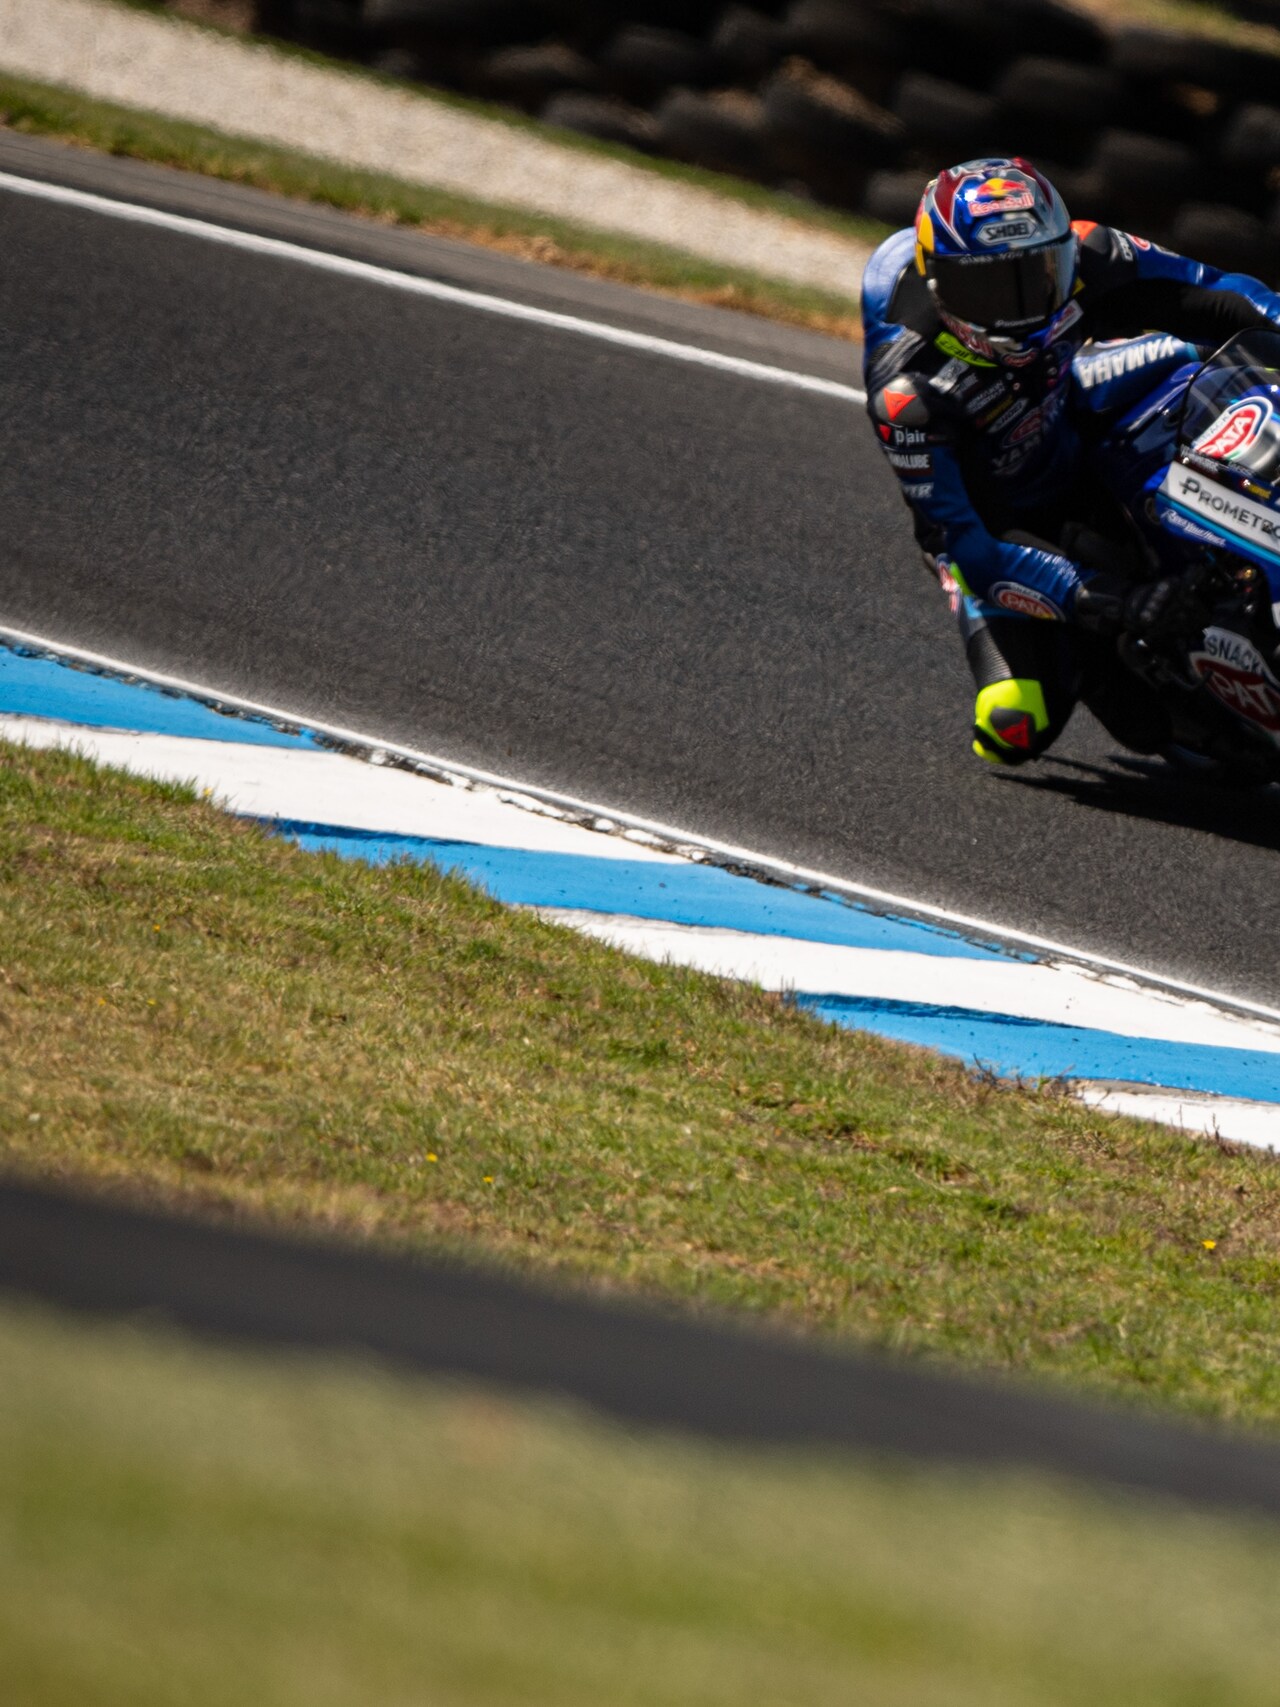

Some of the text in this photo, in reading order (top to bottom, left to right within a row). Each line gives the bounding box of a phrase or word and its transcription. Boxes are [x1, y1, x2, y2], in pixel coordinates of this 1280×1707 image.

[985, 222, 1029, 240] SHOEI
[1077, 335, 1175, 389] YAMAHA
[1206, 634, 1265, 674] SNACK
